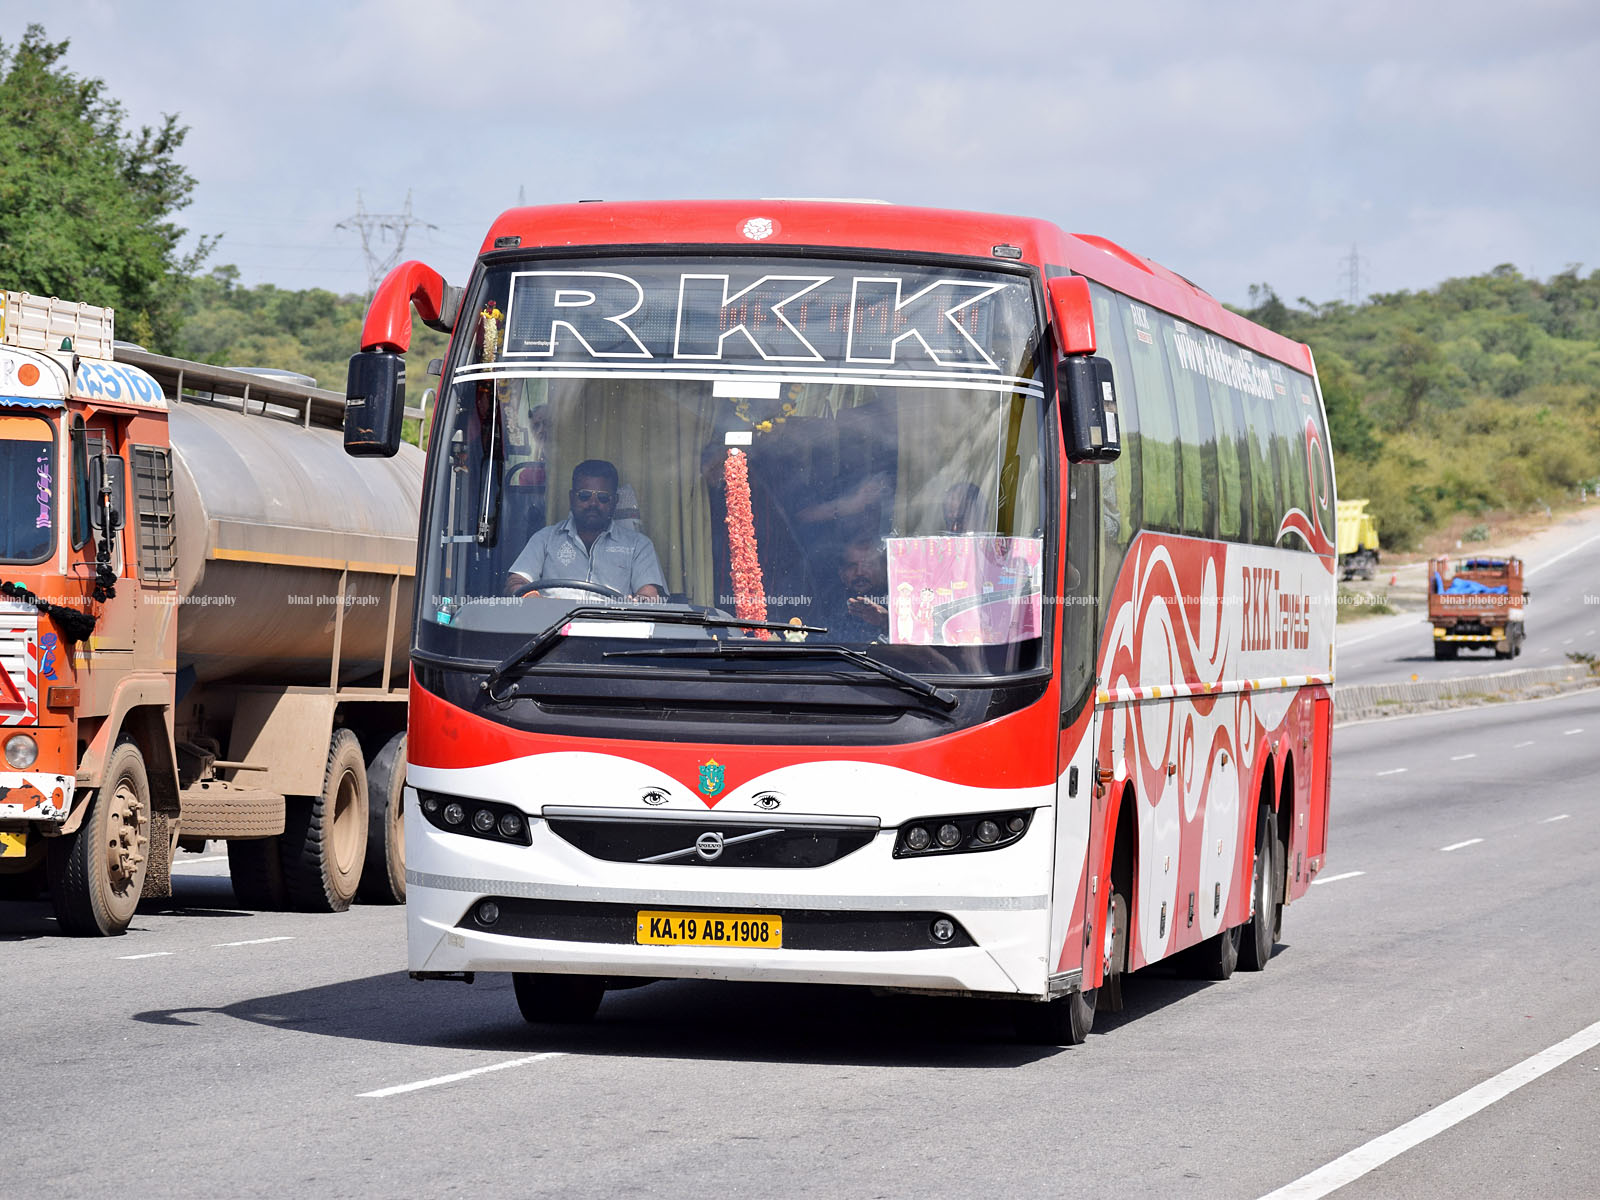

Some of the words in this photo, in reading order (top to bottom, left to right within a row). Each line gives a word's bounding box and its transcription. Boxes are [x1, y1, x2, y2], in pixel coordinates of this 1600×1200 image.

[502, 271, 1007, 370] RKK
[1241, 566, 1272, 651] RKK
[650, 917, 697, 940] KA.19
[702, 919, 769, 943] AB.1908
